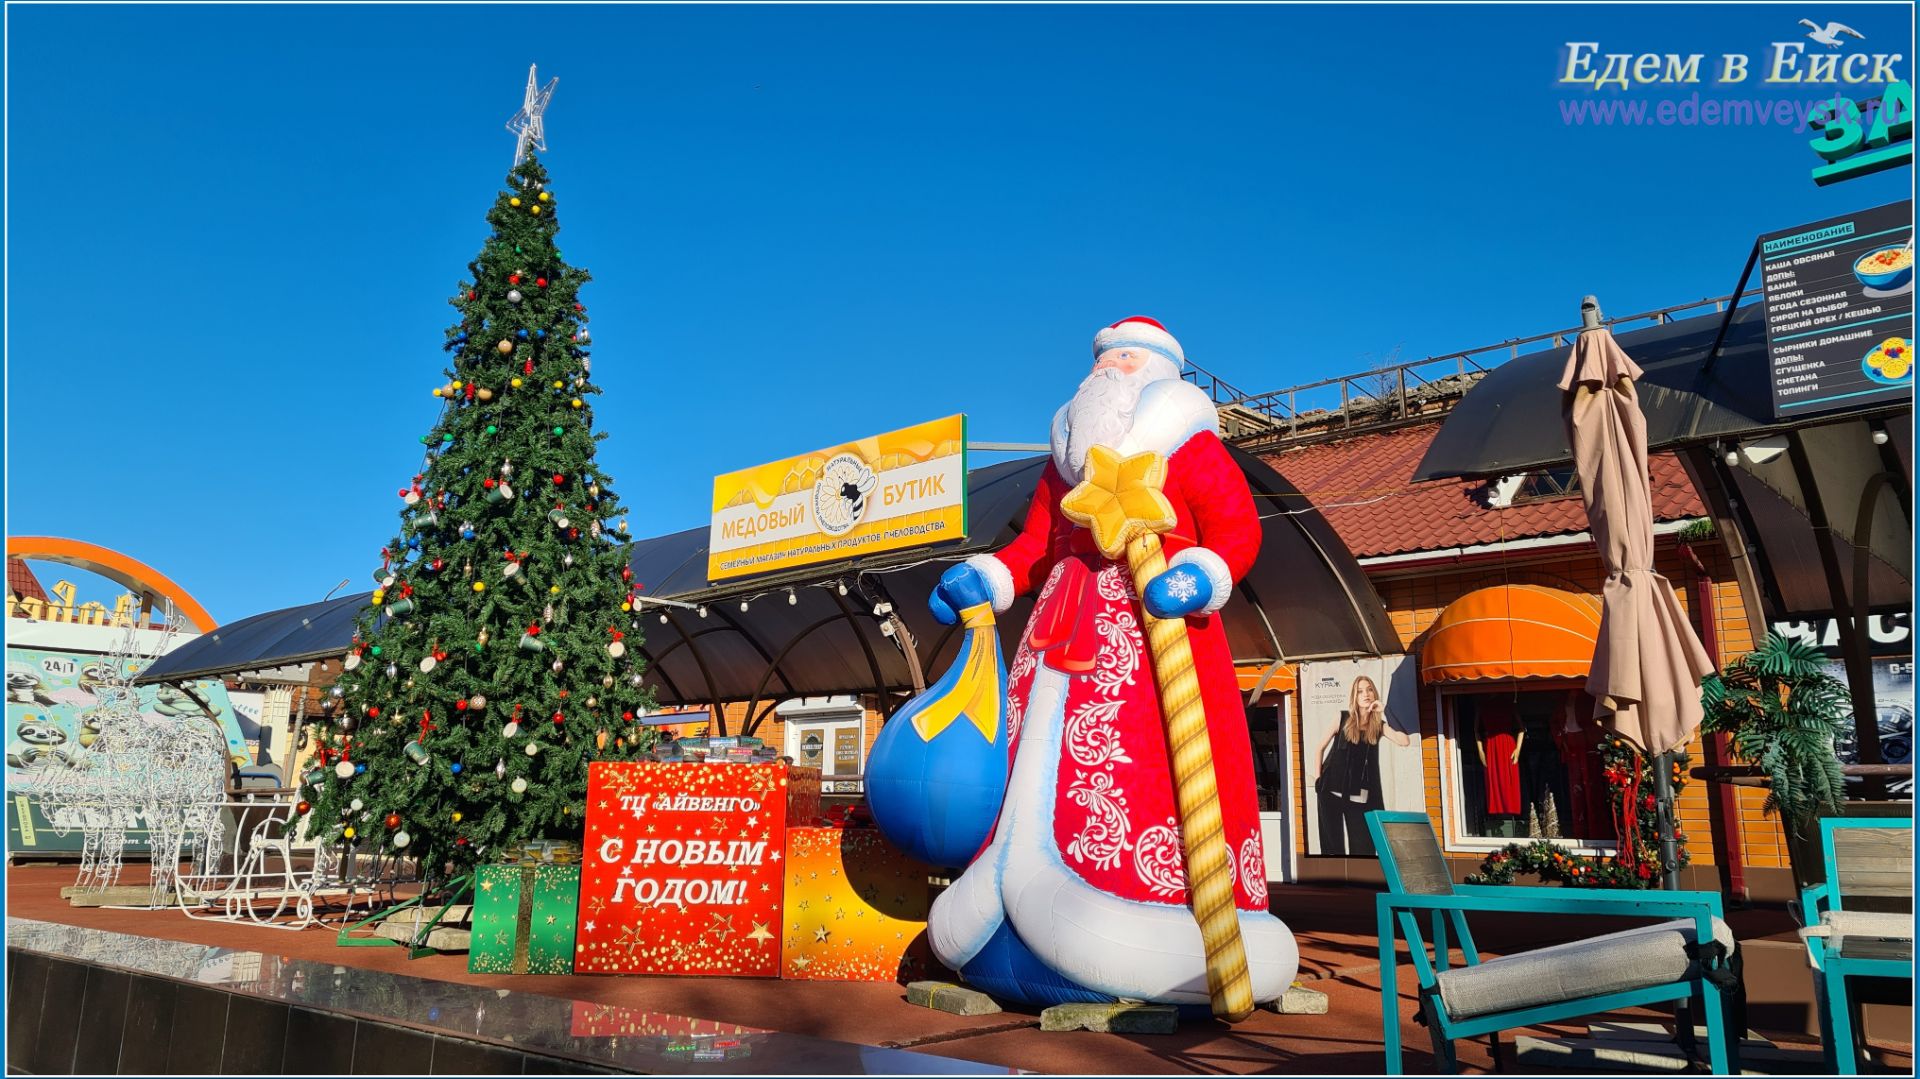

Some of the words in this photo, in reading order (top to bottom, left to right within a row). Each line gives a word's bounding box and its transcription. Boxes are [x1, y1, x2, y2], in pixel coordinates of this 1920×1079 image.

[1765, 224, 1854, 252] НАИМЕНОВАНИЕ
[1765, 260, 1792, 271] КАША
[1793, 250, 1835, 265] ОВСЯНАЯ
[1766, 271, 1796, 282] ДОПЫ:
[1767, 280, 1797, 292] БАНАН
[1769, 289, 1804, 302] ЯБЛОКИ
[1769, 301, 1798, 313] ЯГОДА
[1800, 291, 1847, 306] СЕЗОННАЯ
[1770, 312, 1799, 323] СИРОП
[1802, 309, 1814, 317] НА
[1816, 302, 1849, 314] ВЫБОР
[1771, 319, 1812, 333] ГРЕЦКИЙ
[1814, 314, 1837, 325] ОРЕХ
[1845, 306, 1881, 319] КЕШЬЮ
[1773, 340, 1817, 354] СЫРНИКИ
[1819, 330, 1873, 346] ДОМАШНИЕ
[1774, 354, 1804, 366] ДОПЫ:
[1775, 360, 1826, 375] СГУЩЕНКА
[1776, 373, 1818, 386] СМЕТАНА
[1778, 383, 1819, 397] ТОПИНГИ
[721, 503, 805, 540] МЕДОВЫЙ
[883, 472, 946, 506] БУТИК
[719, 554, 755, 571] СЕМЕЙНЫЙ
[755, 550, 786, 564] МАГАЗИН
[787, 541, 837, 558] НАТУРАЛЬНЫХ
[838, 533, 881, 549] ПРОДУКТОВ
[883, 521, 945, 540] ПЧЕЛОВОДСТВА
[44, 660, 75, 673] 24/7
[620, 795, 648, 813] ТЦ
[652, 792, 761, 813] «АЙВЕНГО»
[599, 838, 624, 863] С
[631, 840, 768, 866] НОВЫМ
[611, 877, 748, 909] ГОДОМ!
